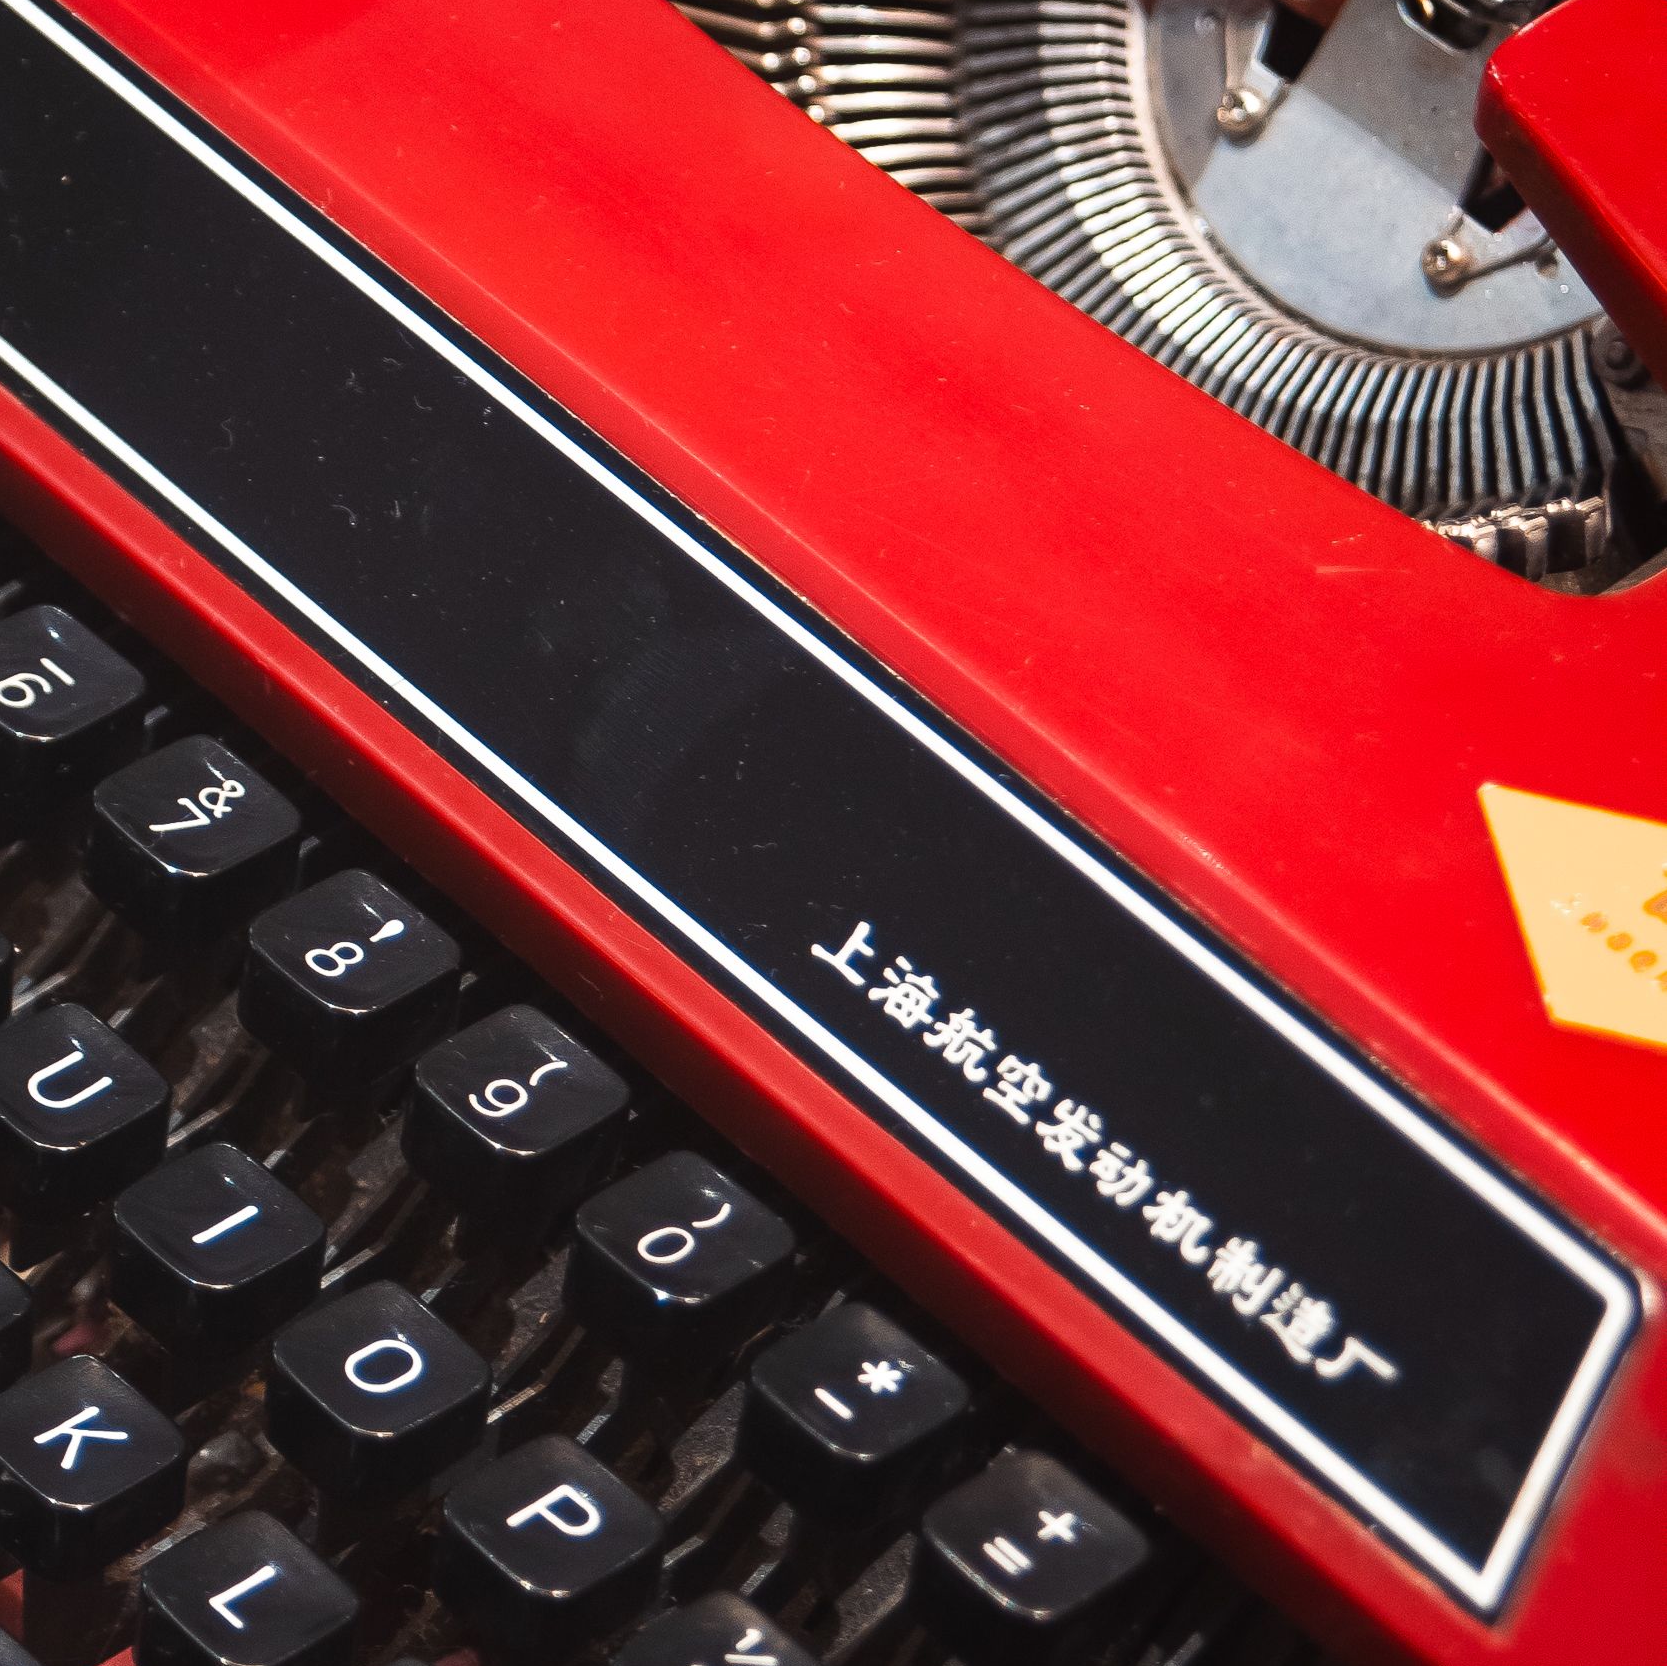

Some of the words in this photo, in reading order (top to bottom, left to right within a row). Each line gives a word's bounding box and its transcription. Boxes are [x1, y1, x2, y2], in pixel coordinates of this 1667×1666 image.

[148, 796, 210, 833] 7
[304, 941, 365, 977] 8
[27, 1049, 113, 1109] U
[468, 1078, 529, 1118] 9
[810, 920, 1399, 1382] 上海航空发动机制造厂
[191, 1205, 259, 1244] I
[637, 1225, 695, 1264] 0
[344, 1338, 423, 1394] O
[33, 1405, 129, 1470] K
[506, 1484, 601, 1537] P
[208, 1562, 278, 1629] L
